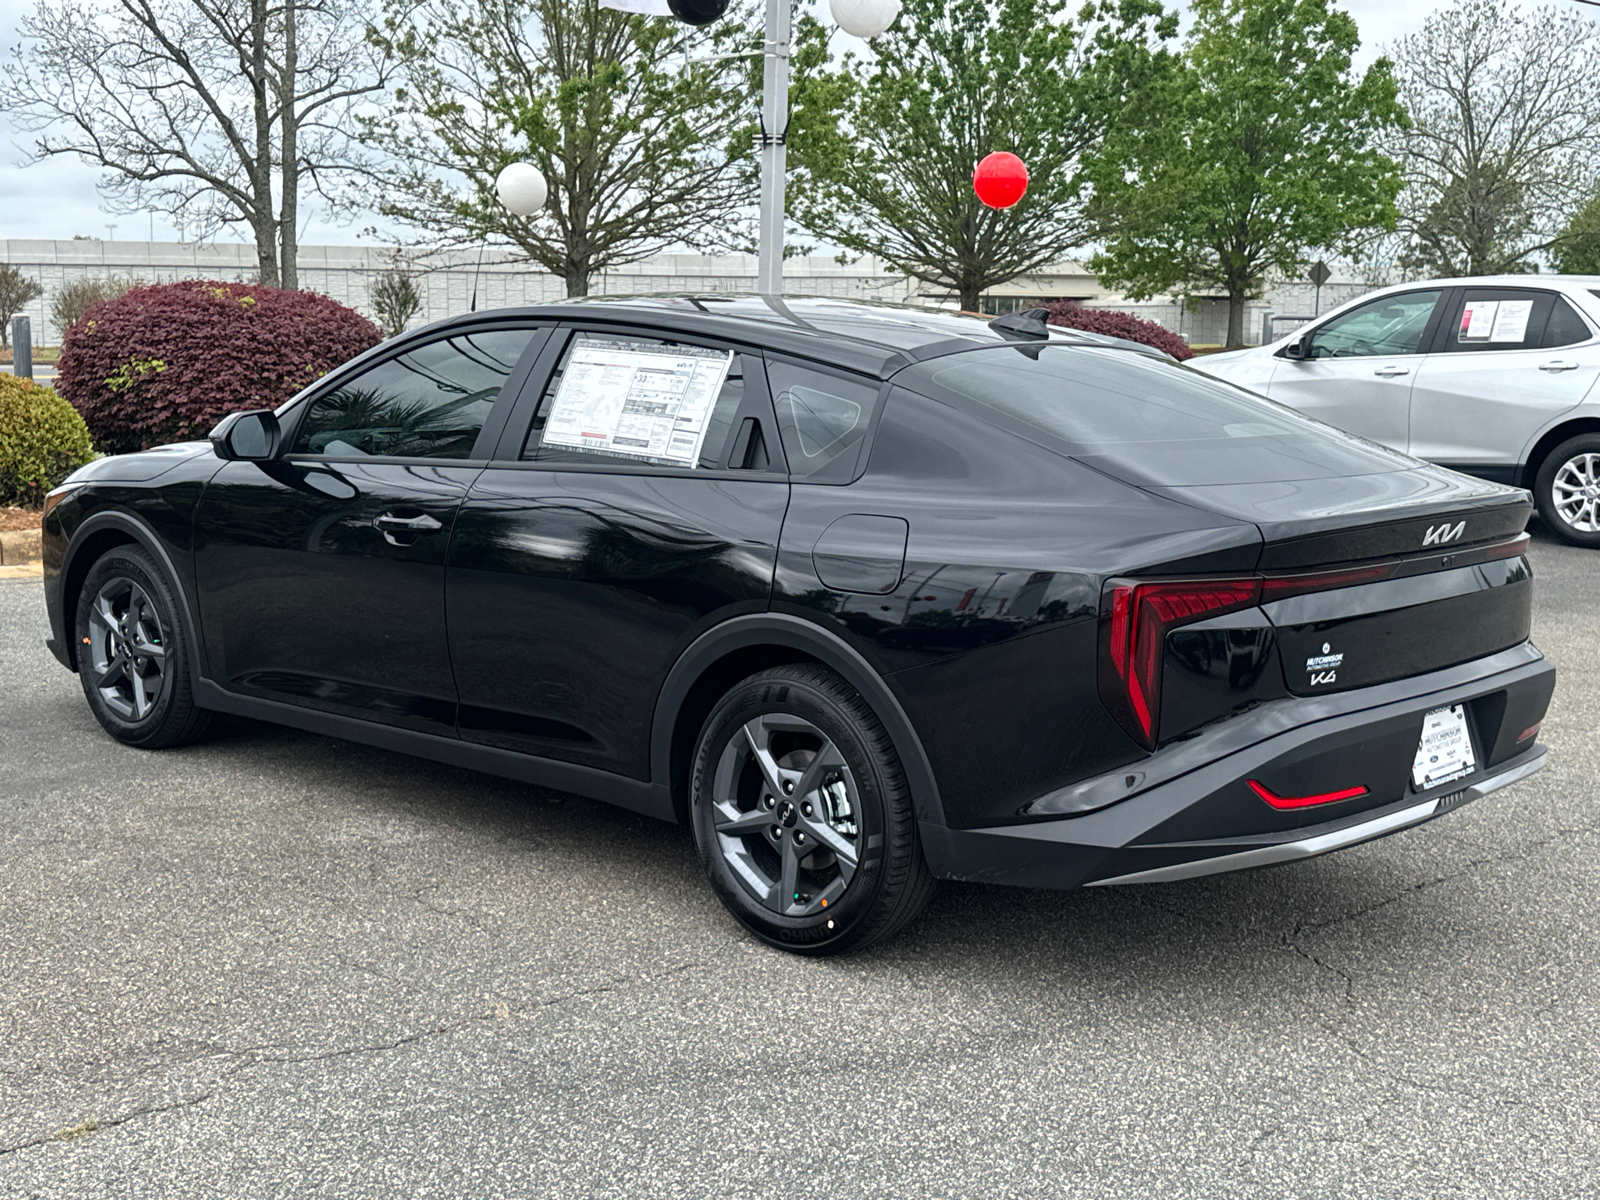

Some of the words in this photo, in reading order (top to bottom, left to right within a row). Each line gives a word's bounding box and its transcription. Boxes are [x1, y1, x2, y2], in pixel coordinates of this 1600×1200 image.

[1421, 520, 1466, 546] KIA
[1310, 670, 1337, 686] K4
[693, 733, 713, 807] SOLUS
